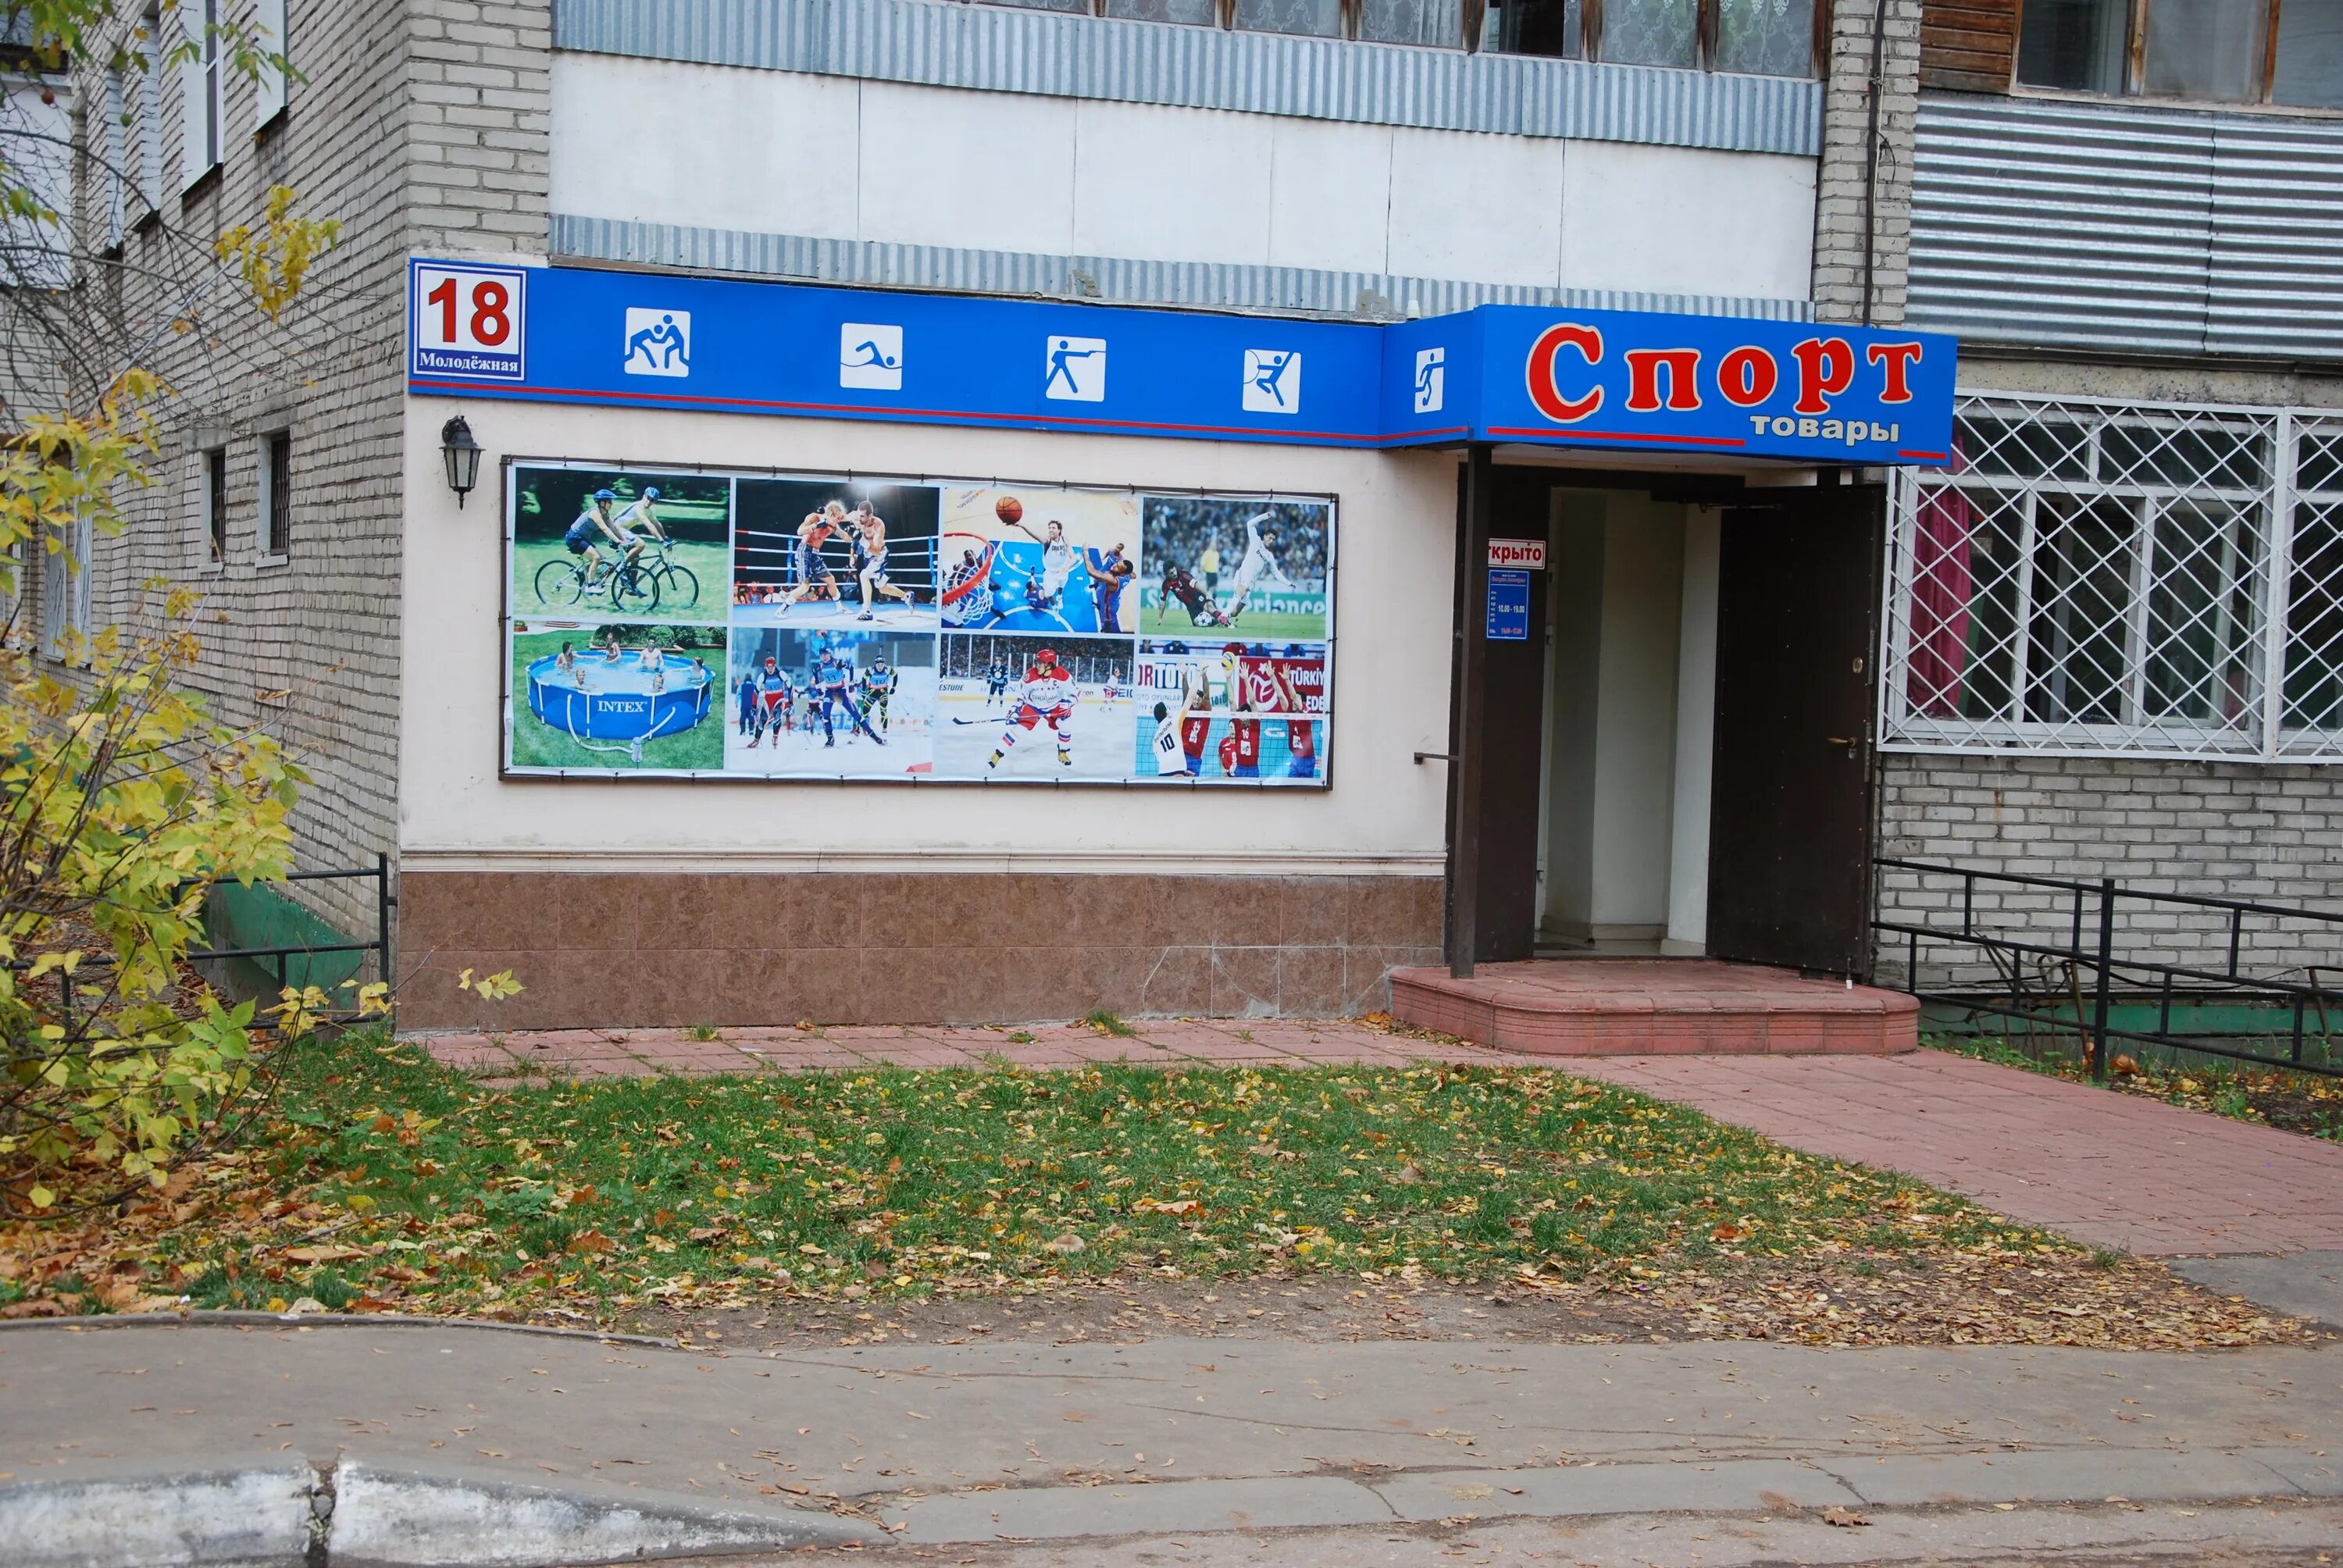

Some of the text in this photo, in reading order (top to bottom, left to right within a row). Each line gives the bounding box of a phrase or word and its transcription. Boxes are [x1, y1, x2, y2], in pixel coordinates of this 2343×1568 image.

[429, 278, 510, 346] 18
[419, 352, 519, 372] Молодёжная
[1525, 322, 1923, 423] Спорт
[1749, 415, 1900, 446] товары
[1489, 546, 1542, 563] крыто
[1154, 662, 1197, 689] TO
[597, 700, 644, 713] INTEX
[1307, 697, 1324, 711] EDE
[1160, 732, 1175, 753] 10
